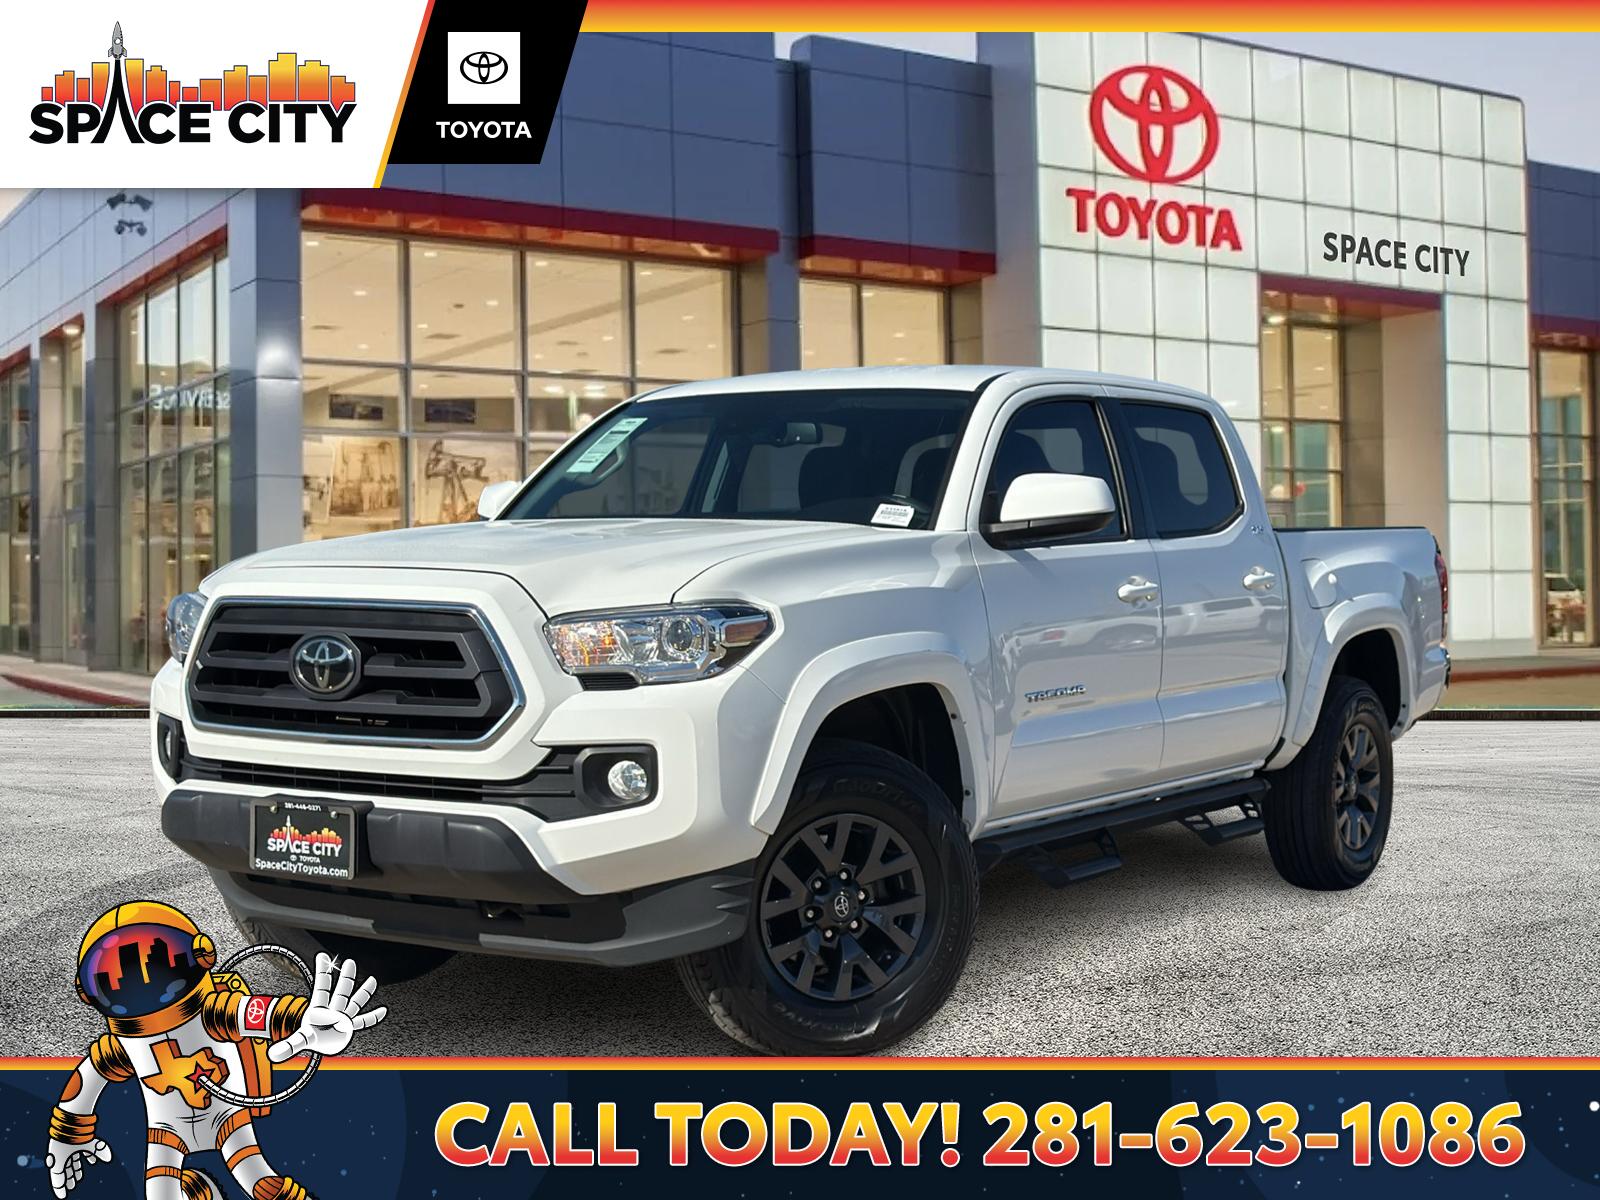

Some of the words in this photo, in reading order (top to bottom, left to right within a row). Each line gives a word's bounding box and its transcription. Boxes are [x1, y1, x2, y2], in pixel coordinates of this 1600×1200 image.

[1066, 188, 1243, 251] TOYOTA
[1323, 232, 1407, 270] SPACE
[1414, 244, 1470, 277] CITY
[1025, 685, 1087, 702] TACOMA
[313, 842, 342, 857] CITY
[256, 859, 348, 877] SpaceCityToyota.com
